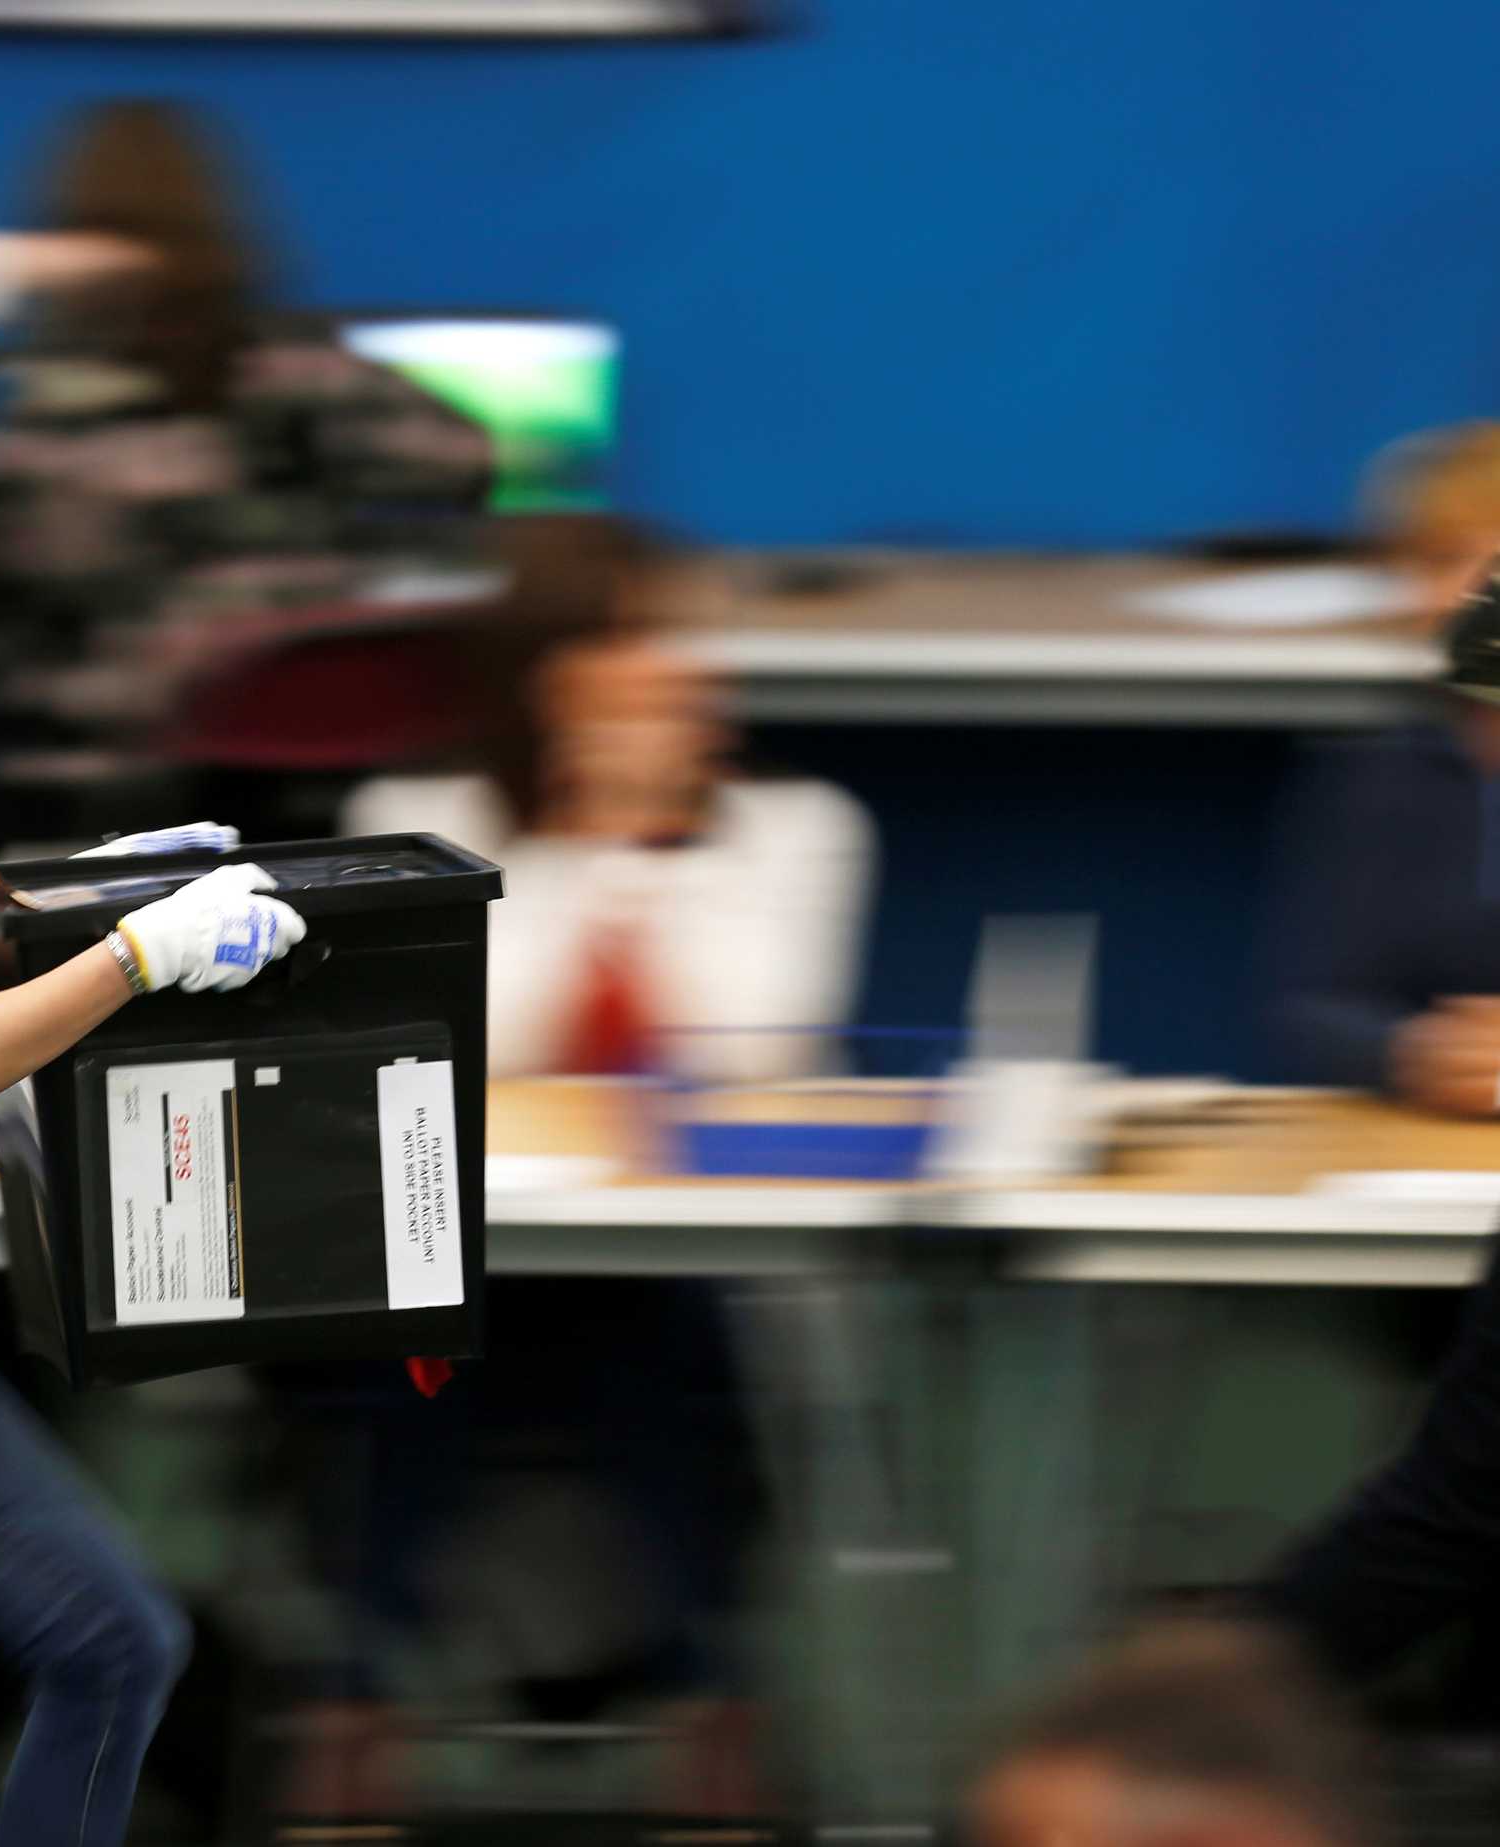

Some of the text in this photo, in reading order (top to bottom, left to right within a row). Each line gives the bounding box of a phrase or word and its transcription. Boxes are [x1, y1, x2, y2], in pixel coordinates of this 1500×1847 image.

[402, 1129, 419, 1243] INTO SIDE POCKET
[415, 1106, 435, 1264] BALLOT PAPER ACCOUNT
[431, 1137, 446, 1231] PLEASE INSERT
